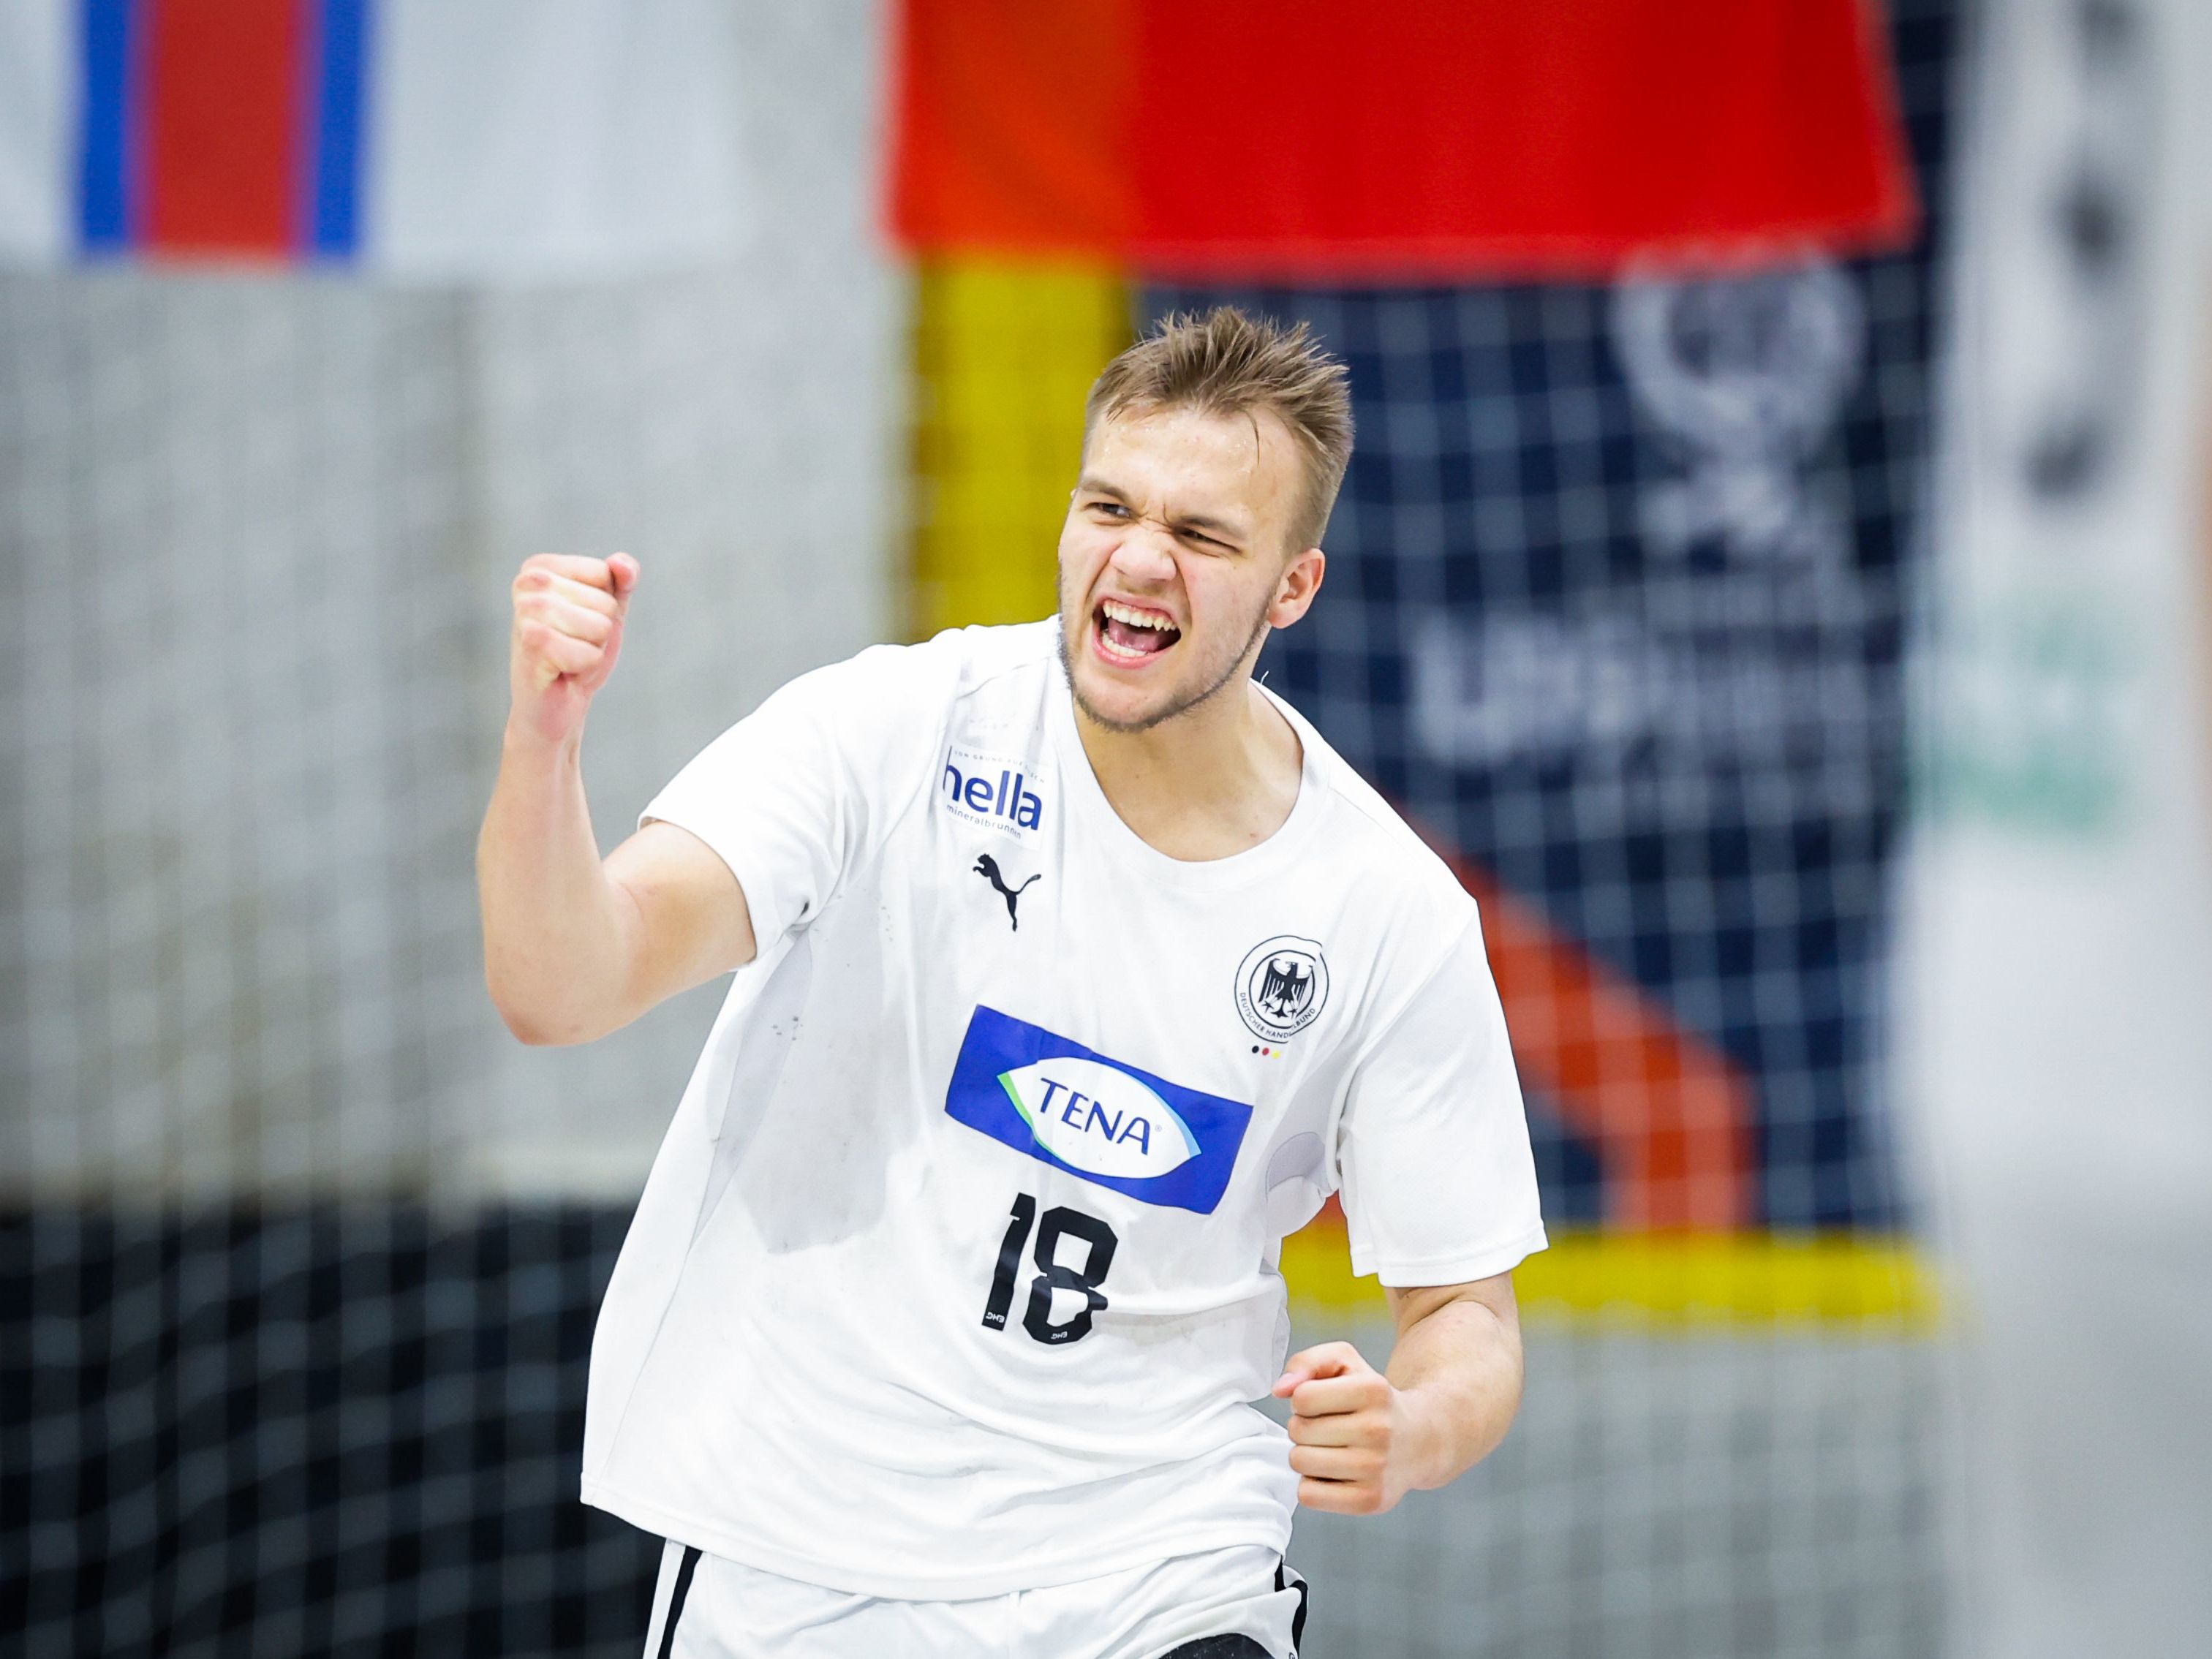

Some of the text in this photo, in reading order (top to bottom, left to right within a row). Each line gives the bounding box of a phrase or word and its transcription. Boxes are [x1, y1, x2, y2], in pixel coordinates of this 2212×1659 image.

[943, 745, 1042, 831] hella
[1240, 992, 1264, 1032] DEUTSCHER
[1040, 1078, 1151, 1155] TENA
[982, 1192, 1118, 1345] 18
